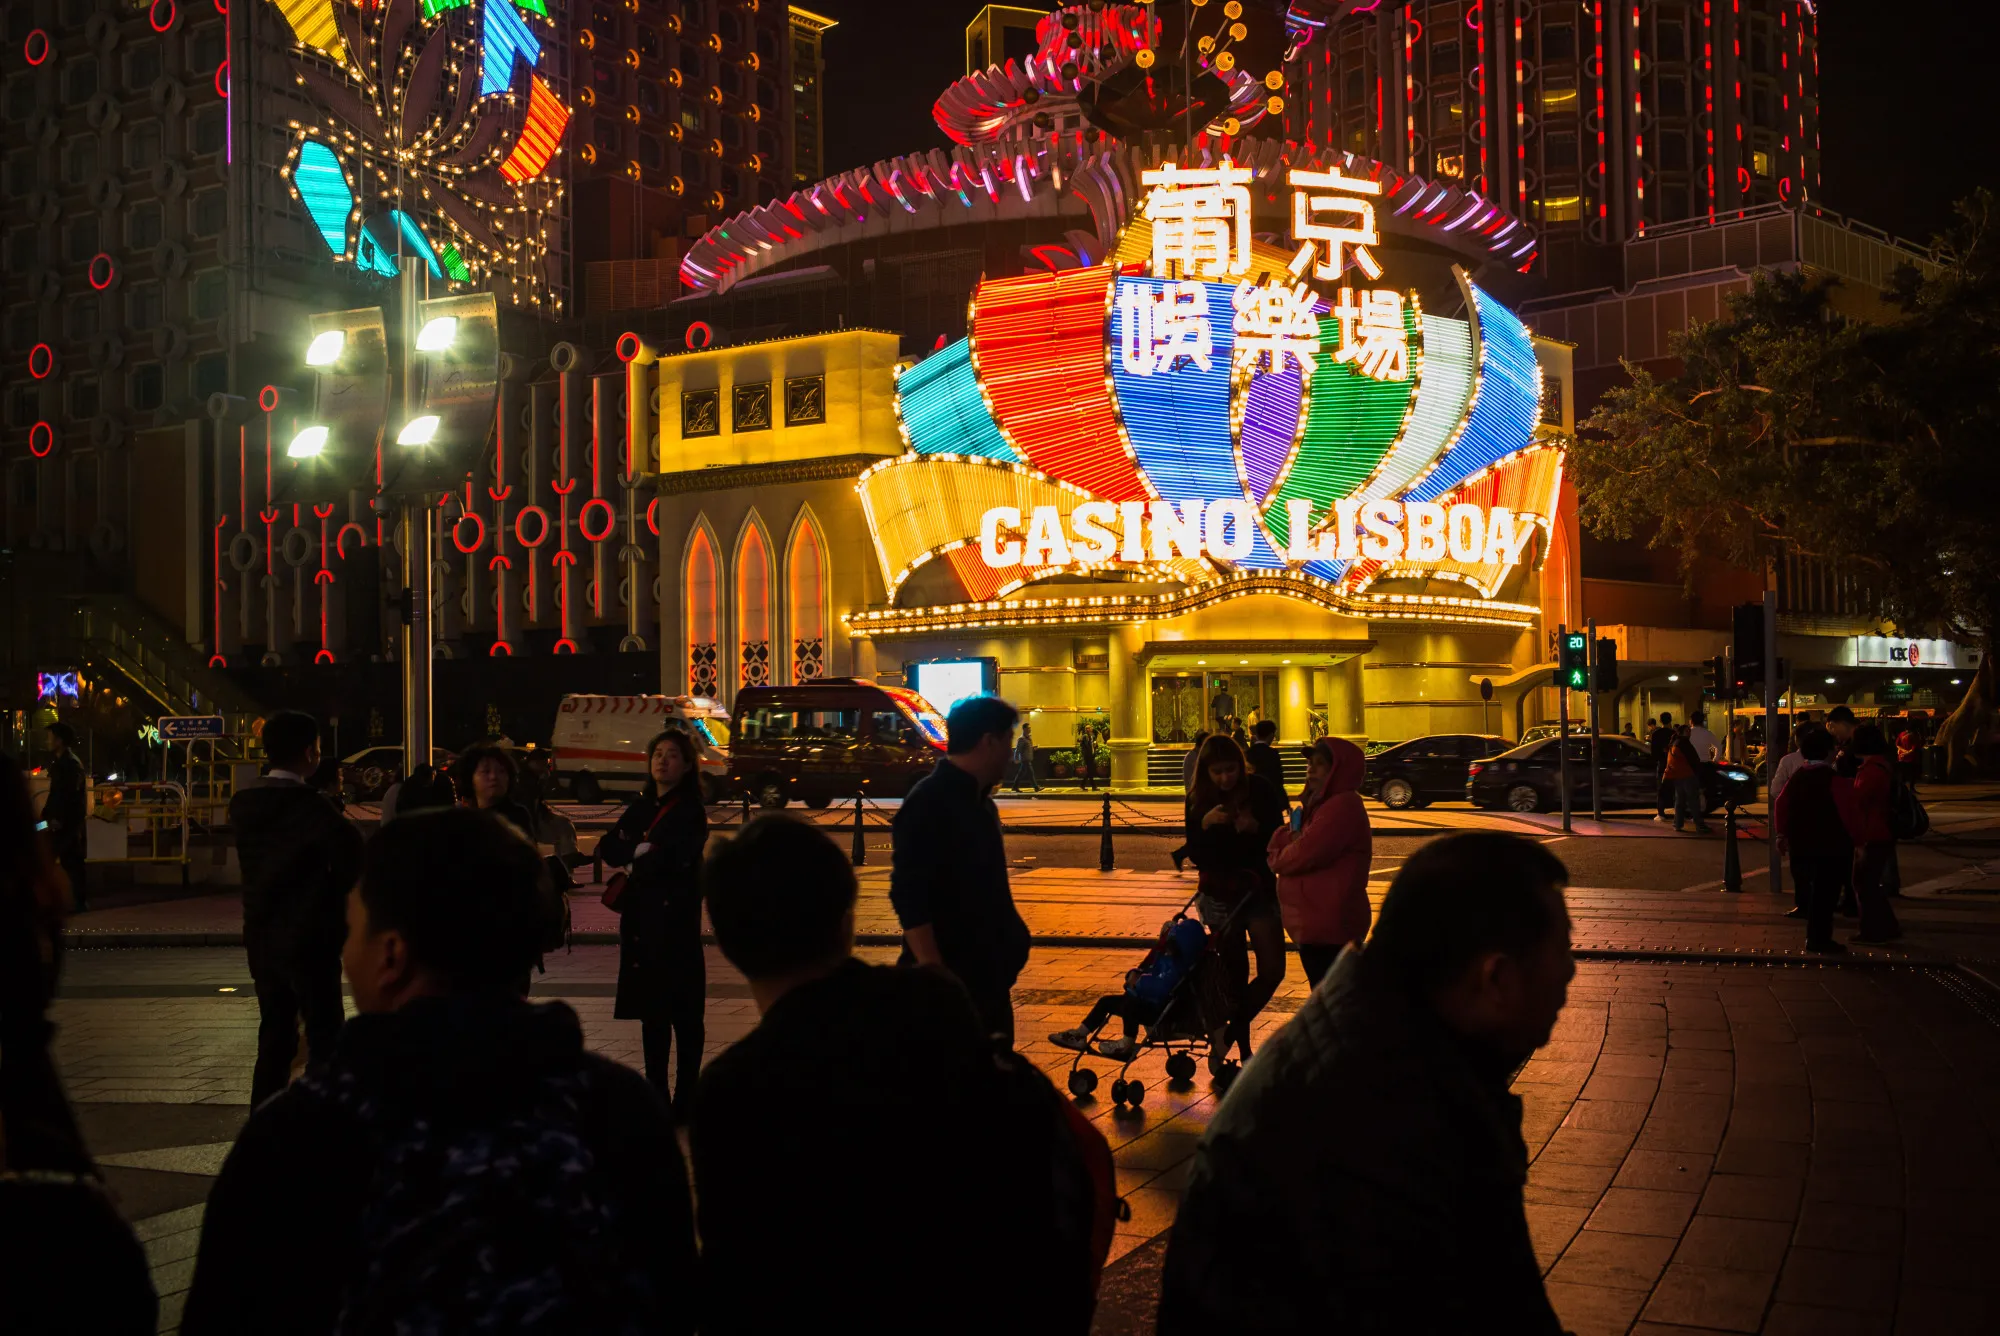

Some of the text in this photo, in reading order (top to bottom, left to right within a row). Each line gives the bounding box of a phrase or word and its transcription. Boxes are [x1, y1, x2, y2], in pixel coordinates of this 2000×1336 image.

[1141, 160, 1384, 281] 葡京
[1117, 280, 1410, 382] 娛樂場
[980, 499, 1521, 569] CASINO LISBOA
[1569, 636, 1583, 649] 20
[1890, 647, 1908, 661] ICBC
